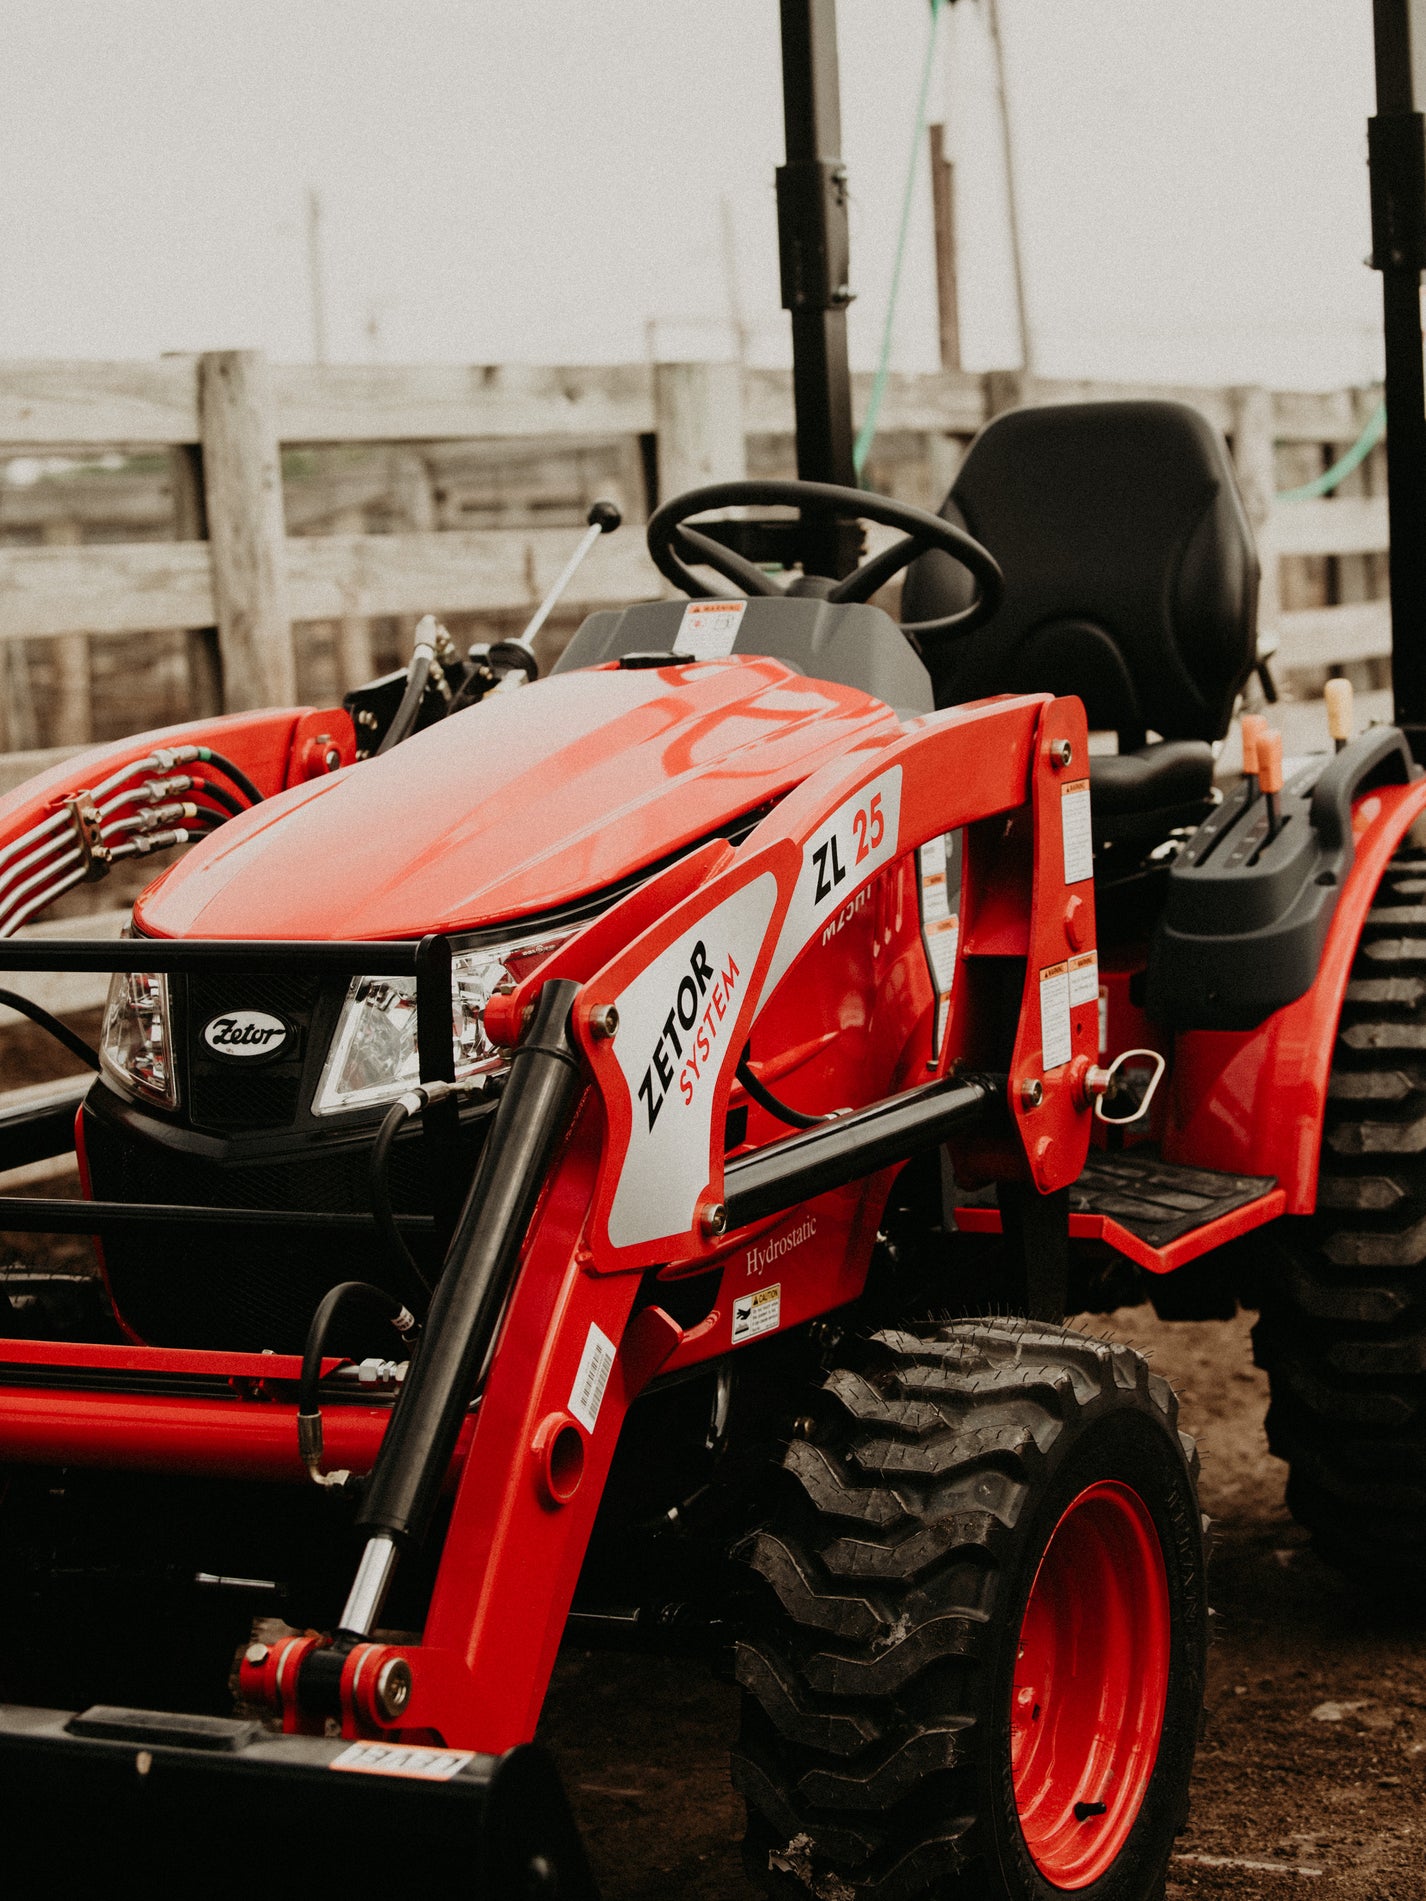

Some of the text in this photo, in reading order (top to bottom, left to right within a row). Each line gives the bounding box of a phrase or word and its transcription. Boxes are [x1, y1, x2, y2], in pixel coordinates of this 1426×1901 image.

[812, 792, 885, 906] ZL 25
[212, 1018, 286, 1045] Zetor
[638, 940, 714, 1134] ZETOR
[680, 953, 740, 1106] SYSTEM
[746, 1215, 817, 1276] Hydrostatic
